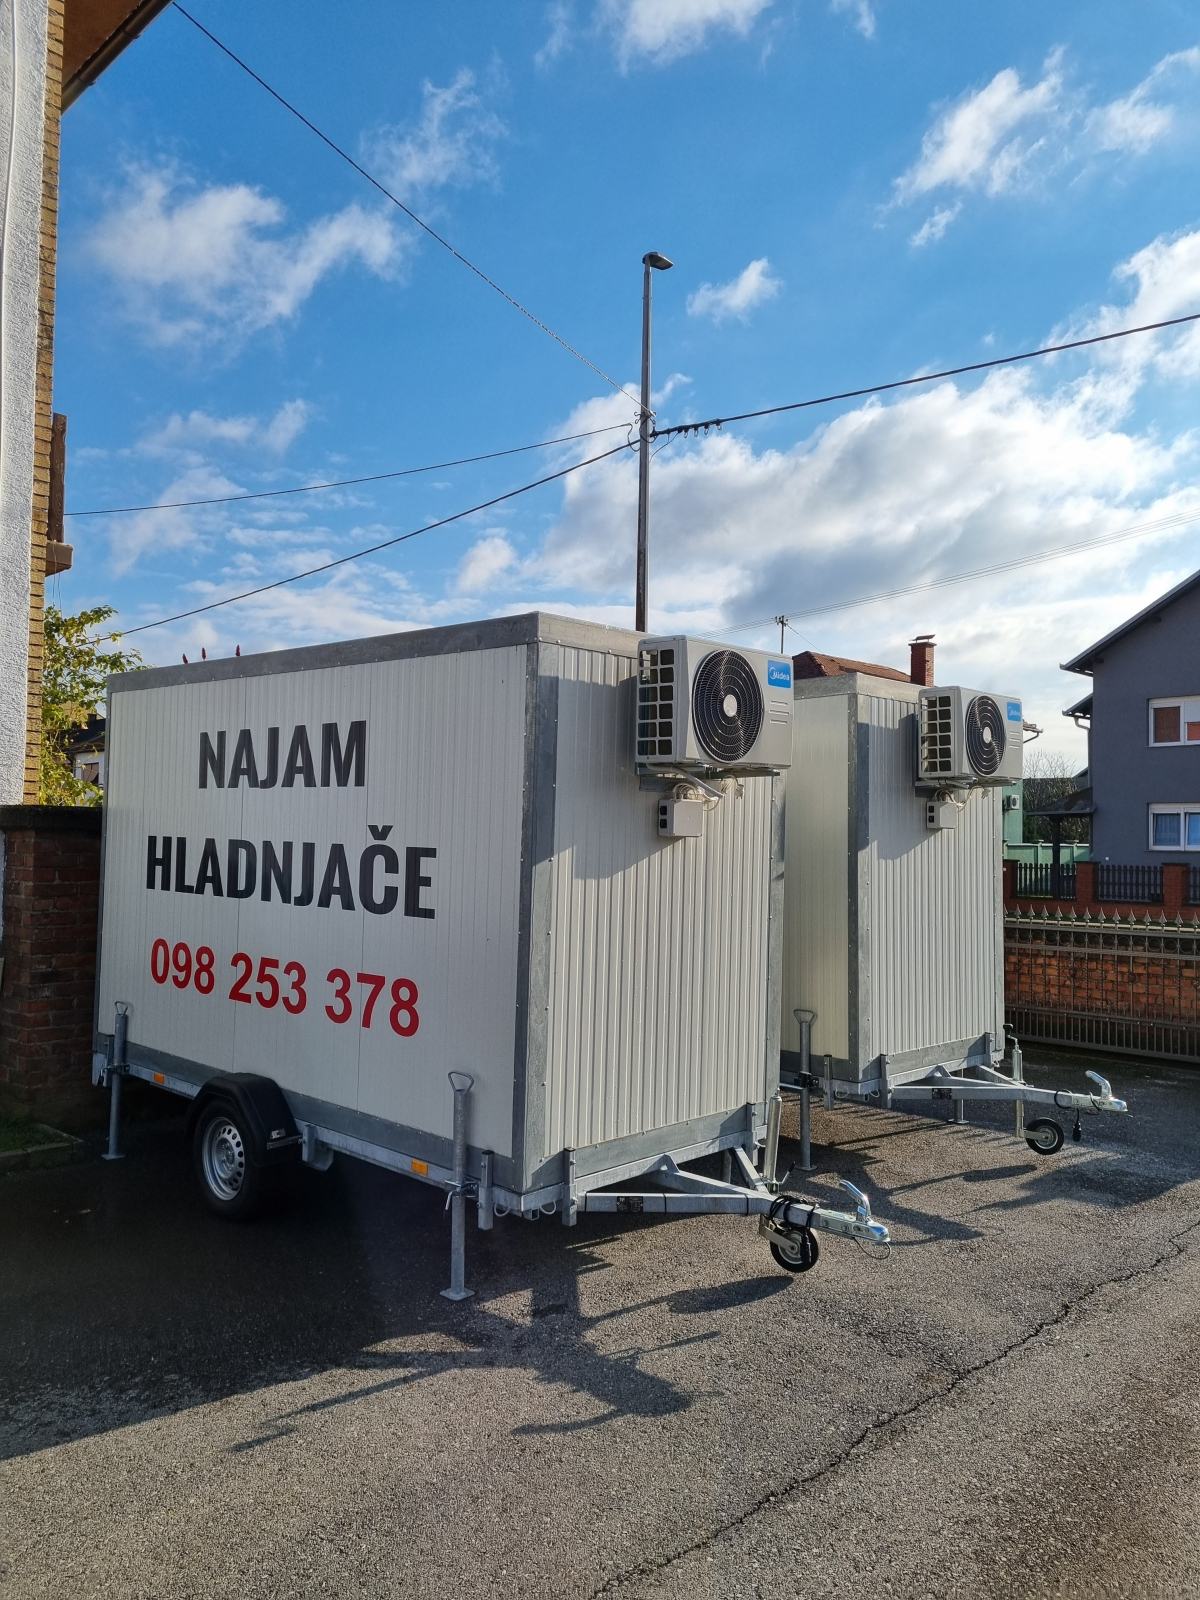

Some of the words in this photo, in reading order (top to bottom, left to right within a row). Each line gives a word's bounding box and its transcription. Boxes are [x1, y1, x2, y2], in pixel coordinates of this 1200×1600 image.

[198, 719, 367, 790] NAJAM
[145, 824, 437, 920] HLADNJAČE
[151, 938, 215, 994] 098
[230, 952, 307, 1014] 253
[325, 968, 419, 1037] 378
